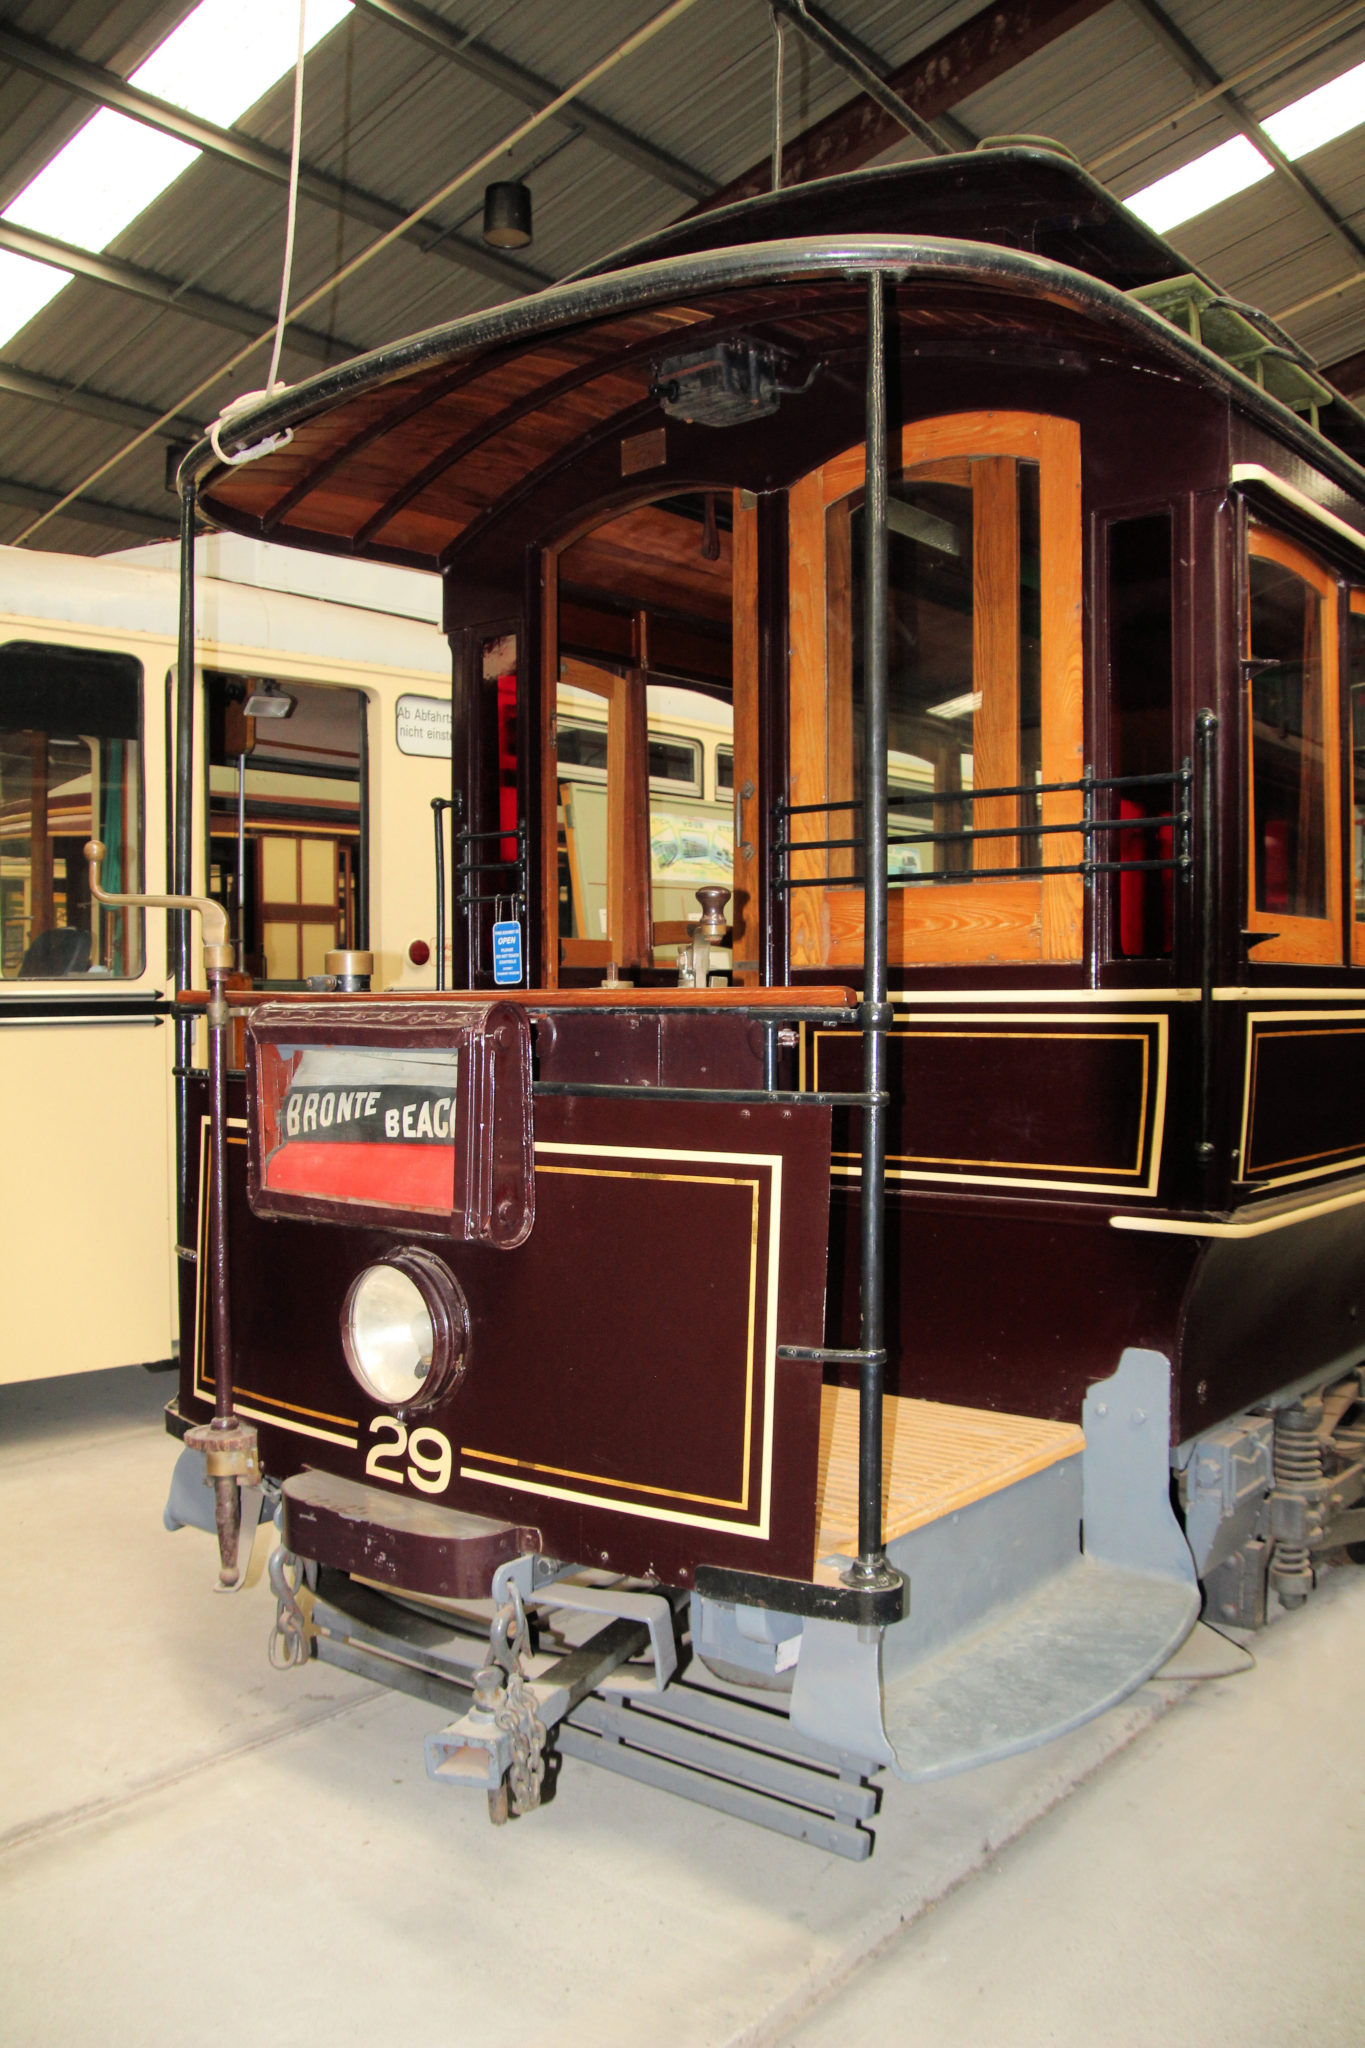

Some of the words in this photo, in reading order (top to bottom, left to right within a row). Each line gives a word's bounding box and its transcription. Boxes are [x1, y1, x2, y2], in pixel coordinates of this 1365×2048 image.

[398, 706, 411, 720] Ab
[400, 724, 423, 738] nicht
[497, 936, 516, 945] OPEN
[286, 1091, 382, 1137] BRONTE
[365, 1415, 452, 1494] 29
